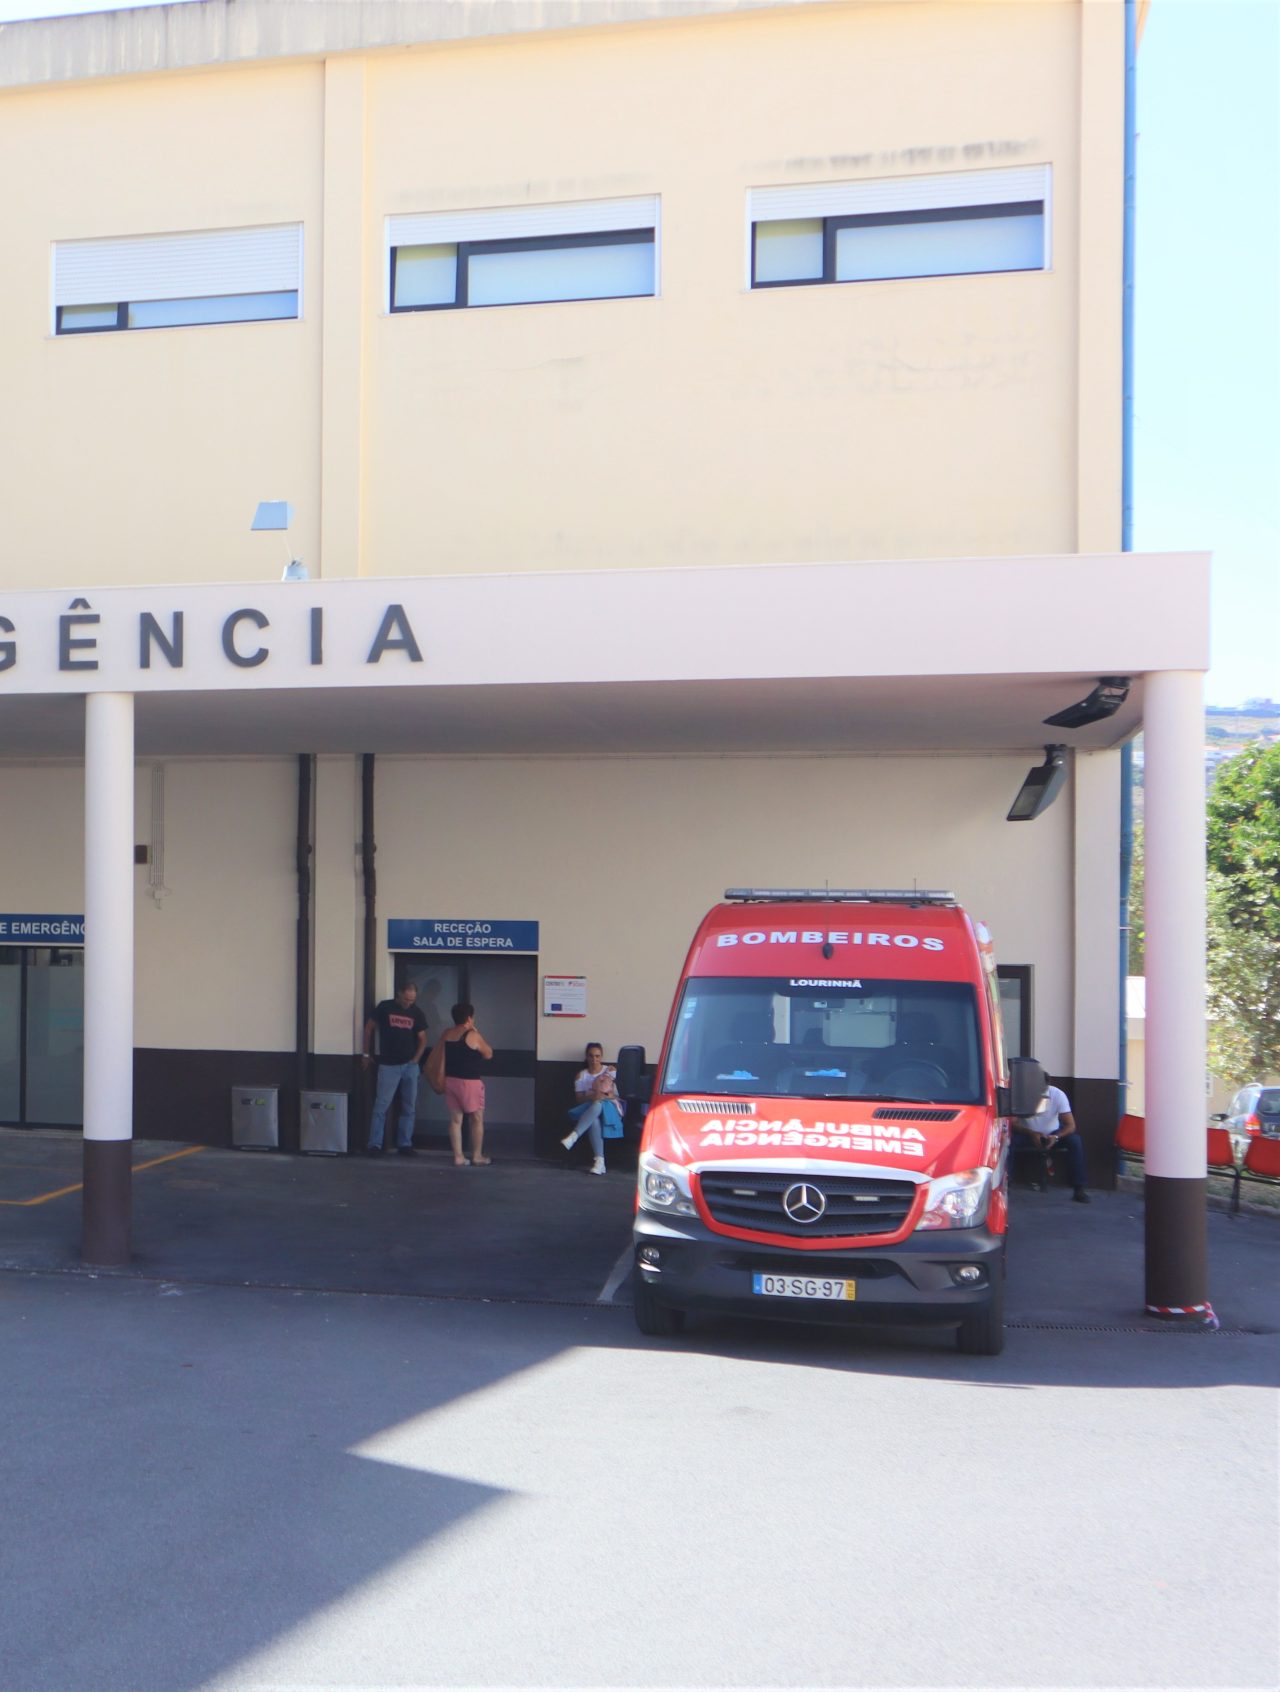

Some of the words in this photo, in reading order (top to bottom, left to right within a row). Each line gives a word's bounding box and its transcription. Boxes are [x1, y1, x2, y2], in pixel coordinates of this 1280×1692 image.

[434, 921, 492, 936] RECEÇÃO
[412, 935, 445, 947] SALA
[446, 936, 464, 947] DE
[465, 936, 514, 948] ESPERA
[716, 930, 945, 952] BOMBEIROS
[789, 978, 863, 989] LOURINHÃ
[764, 1277, 845, 1298] 03-SG-97
